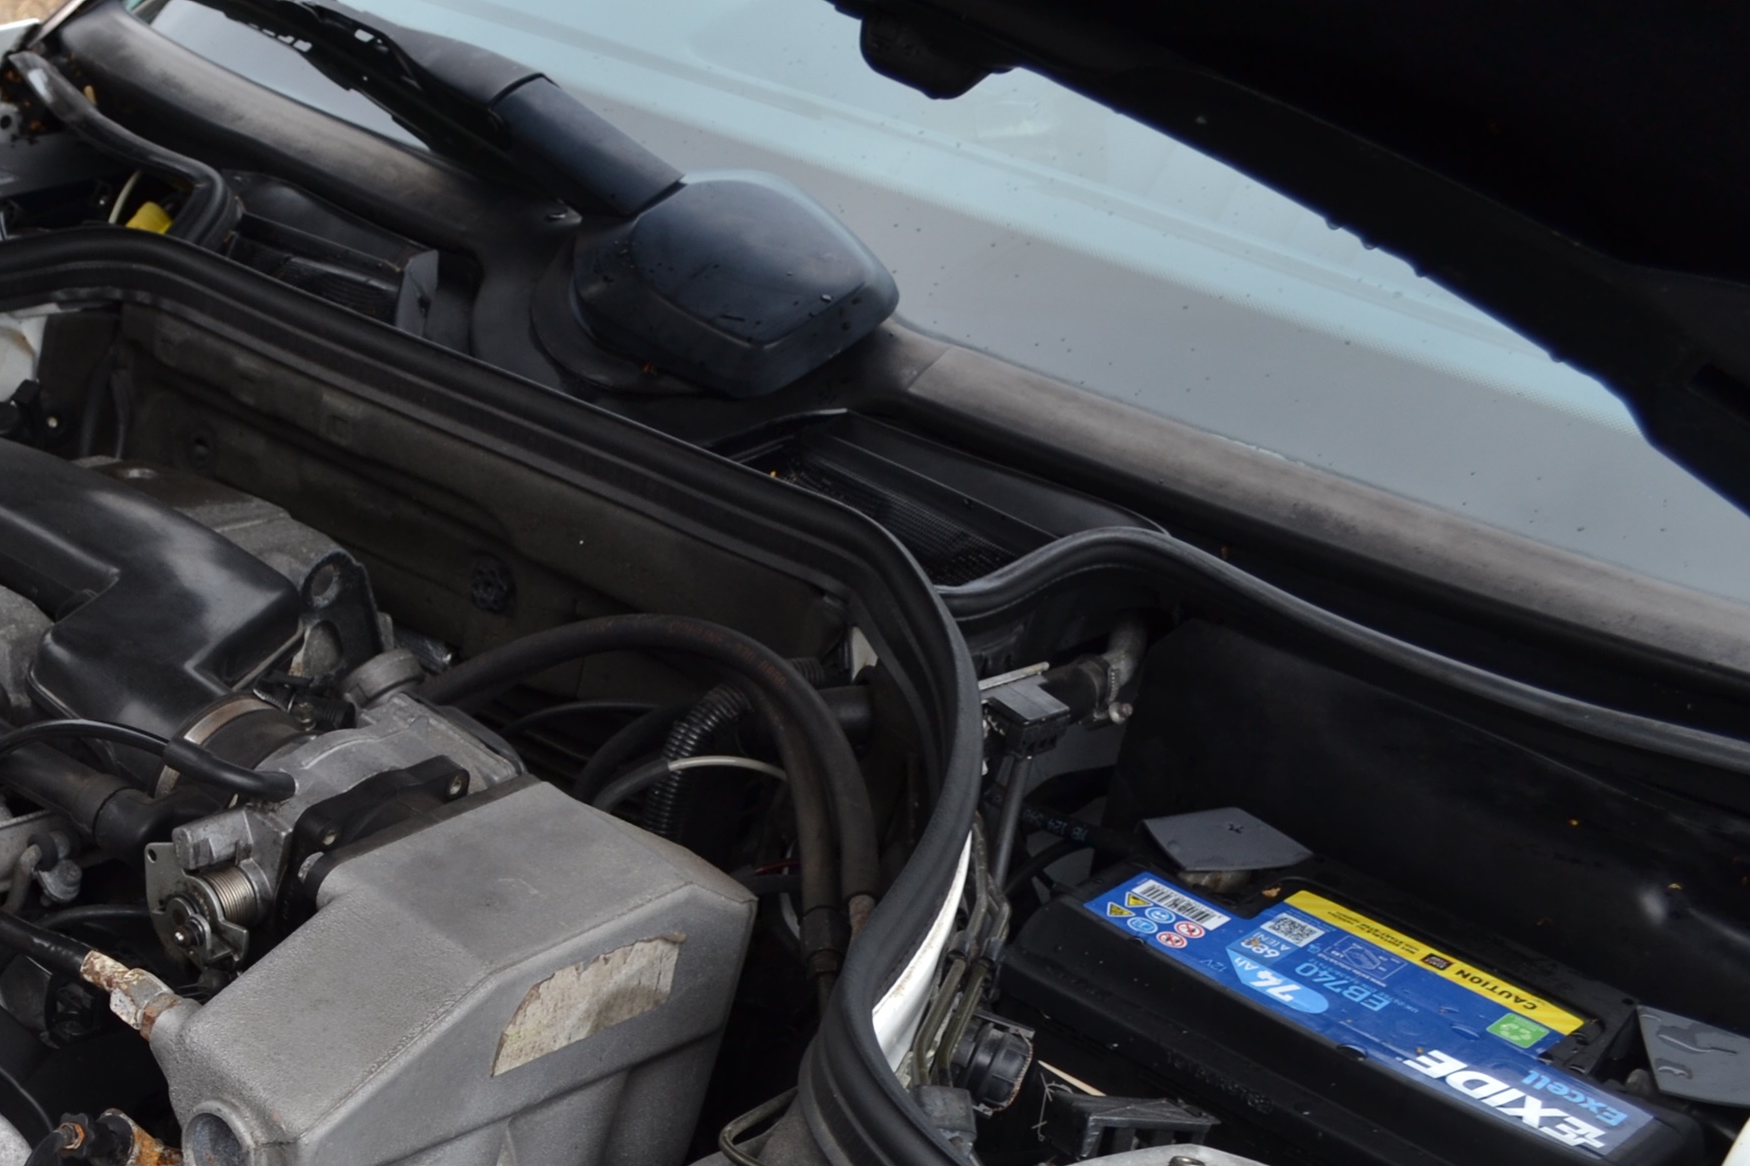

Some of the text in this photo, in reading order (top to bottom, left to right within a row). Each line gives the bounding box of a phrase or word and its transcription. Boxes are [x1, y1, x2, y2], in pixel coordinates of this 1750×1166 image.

[1234, 957, 1259, 971] Ah
[1251, 970, 1301, 1002] 74
[1295, 962, 1391, 1012] EB740
[1455, 969, 1538, 1011] CAUTION
[1403, 1050, 1606, 1149] EXIDE
[1521, 1069, 1628, 1126] Excell
